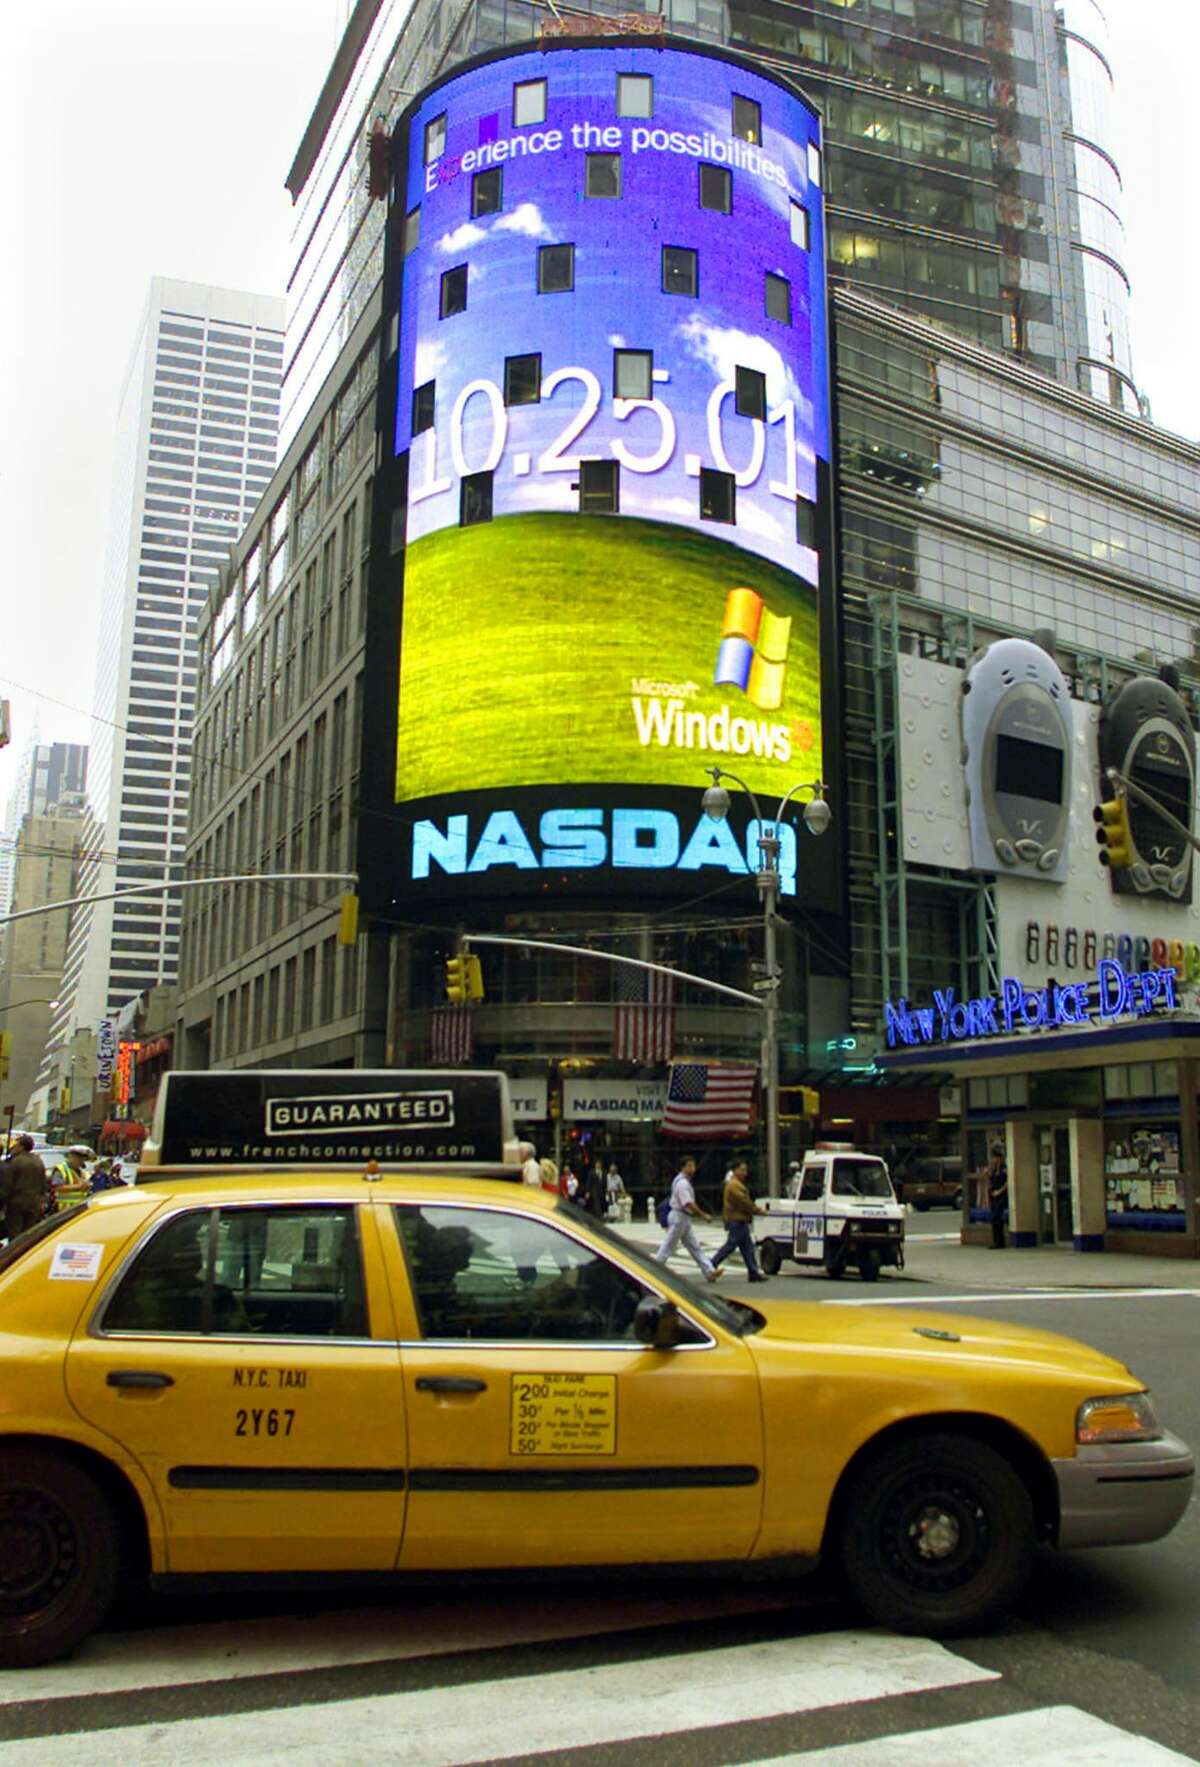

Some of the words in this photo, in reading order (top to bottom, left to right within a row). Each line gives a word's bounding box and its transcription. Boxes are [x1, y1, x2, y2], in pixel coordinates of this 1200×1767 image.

[570, 121, 622, 149] the
[631, 678, 700, 698] Microsoft
[632, 697, 792, 763] Windows
[411, 807, 797, 896] NASDAQ
[933, 986, 999, 1041] YORK
[1002, 976, 1089, 1033] POLICE
[1097, 958, 1178, 1019] DEPT
[274, 1100, 446, 1125] GUARANTEED
[511, 1099, 537, 1112] TE
[573, 1099, 638, 1114] NASDAQ
[641, 1100, 664, 1112] MA
[190, 1143, 476, 1158] www.frenchconnection.com
[278, 1368, 307, 1388] TAXI
[235, 1409, 296, 1436] 2Y67
